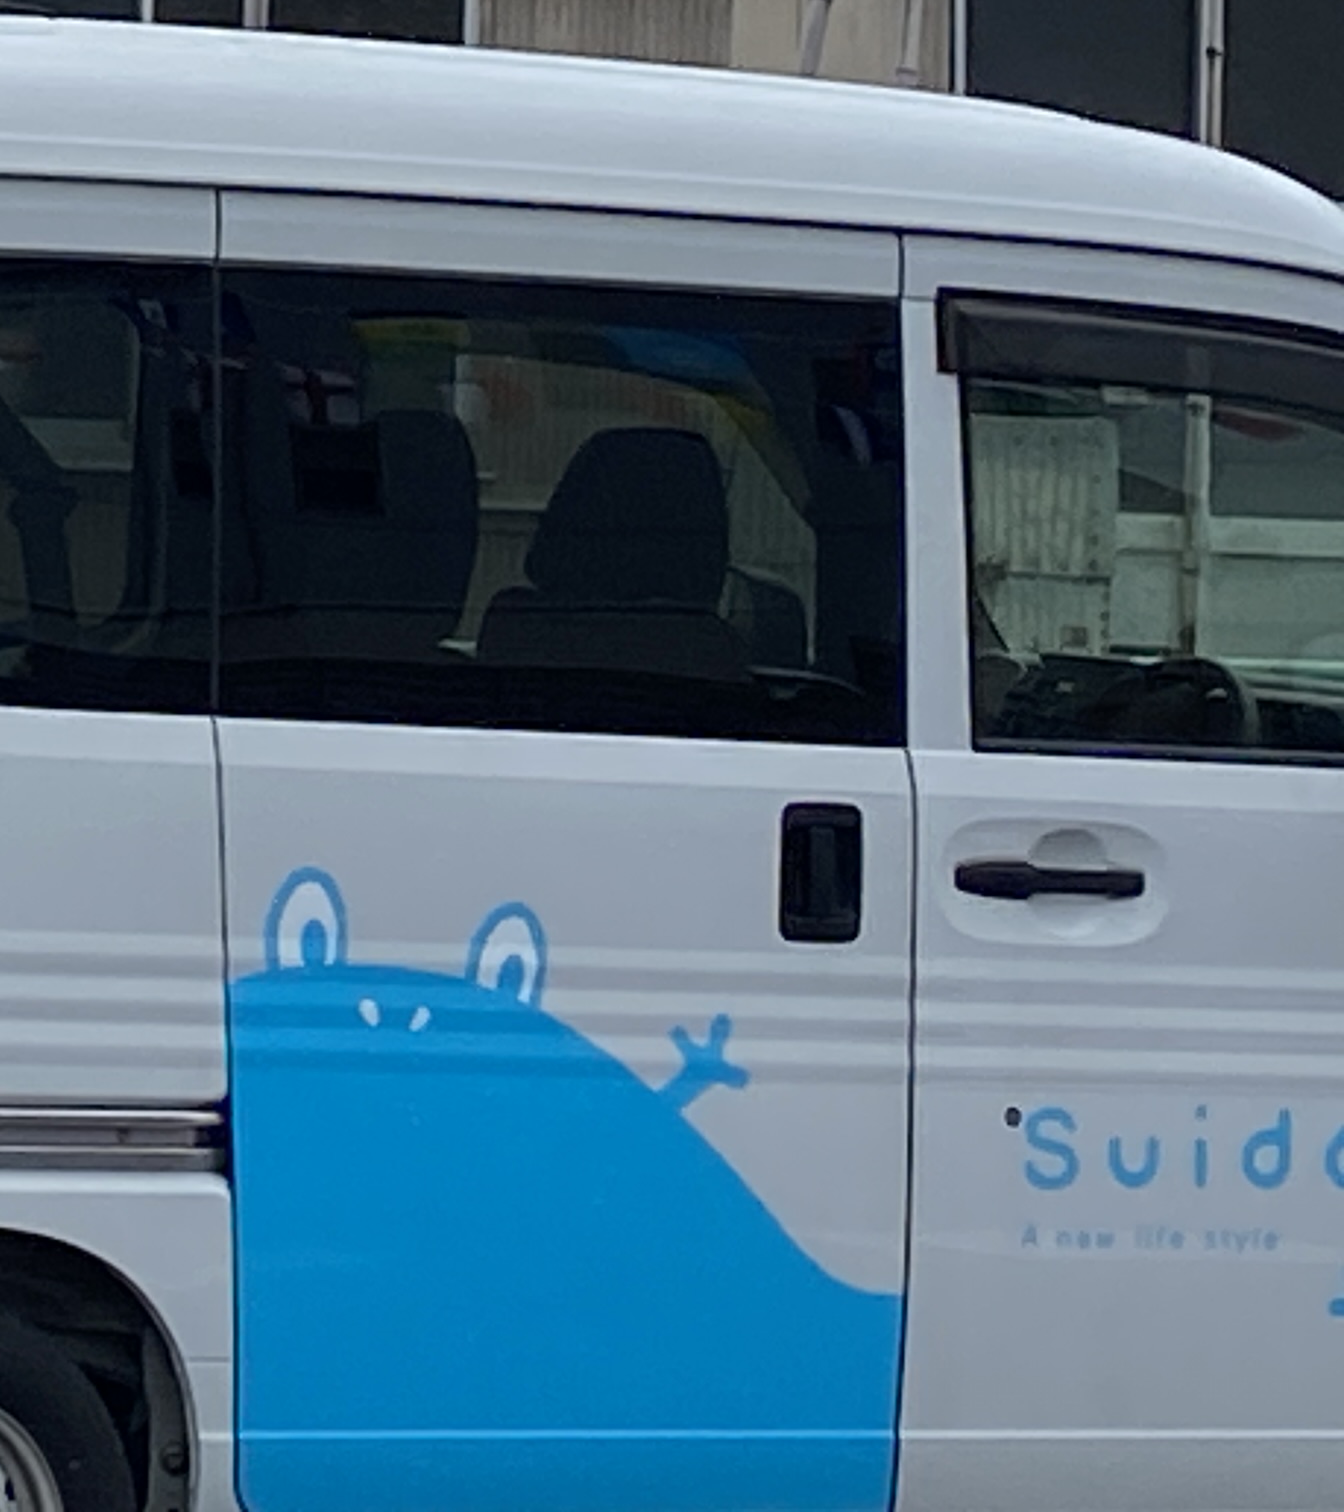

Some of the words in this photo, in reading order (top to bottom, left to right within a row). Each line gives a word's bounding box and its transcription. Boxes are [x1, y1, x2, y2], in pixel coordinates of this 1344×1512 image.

[1020, 1224, 1040, 1248] A
[1055, 1229, 1115, 1250] new
[1133, 1223, 1186, 1251] life
[1204, 1226, 1280, 1255] style
